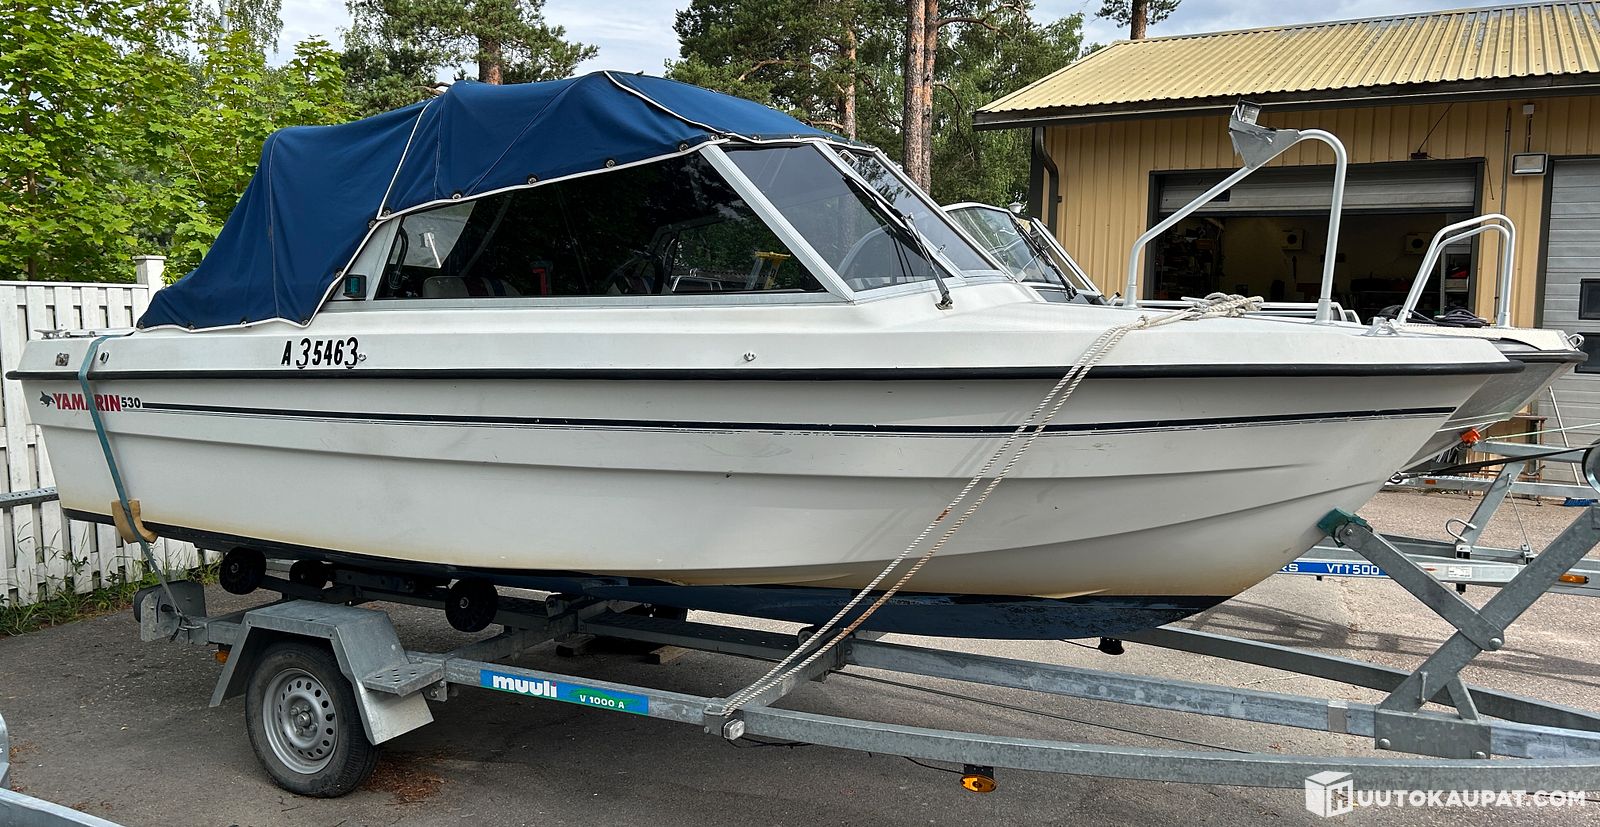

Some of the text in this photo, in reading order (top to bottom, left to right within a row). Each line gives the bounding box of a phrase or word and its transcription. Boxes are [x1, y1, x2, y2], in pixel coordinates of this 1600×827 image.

[281, 337, 359, 369] A 35463
[121, 396, 141, 409] 530
[492, 675, 557, 698] muuli
[589, 696, 615, 708] 1000
[617, 701, 625, 709] A
